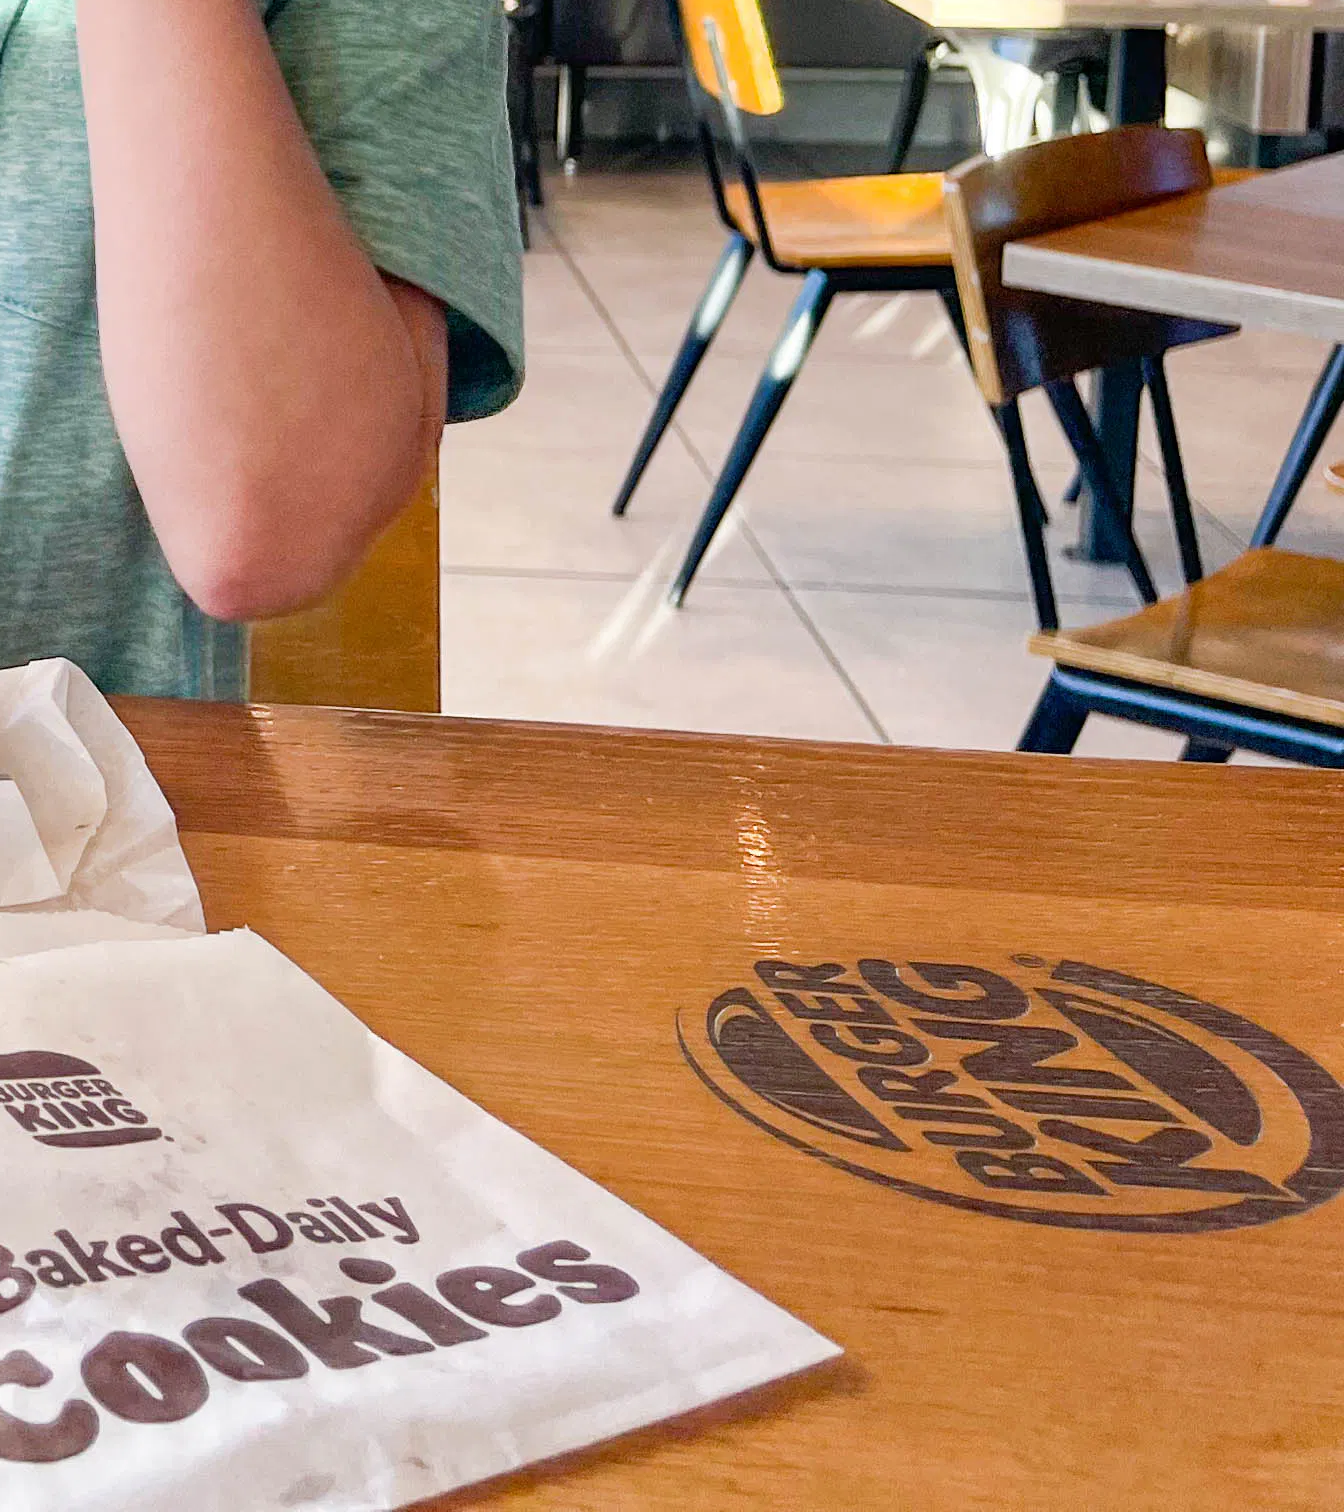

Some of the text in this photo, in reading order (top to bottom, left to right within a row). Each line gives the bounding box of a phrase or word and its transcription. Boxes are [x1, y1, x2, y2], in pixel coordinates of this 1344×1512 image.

[4, 1098, 149, 1133] KING
[753, 958, 1114, 1196] BURGER
[856, 958, 1306, 1202] KING
